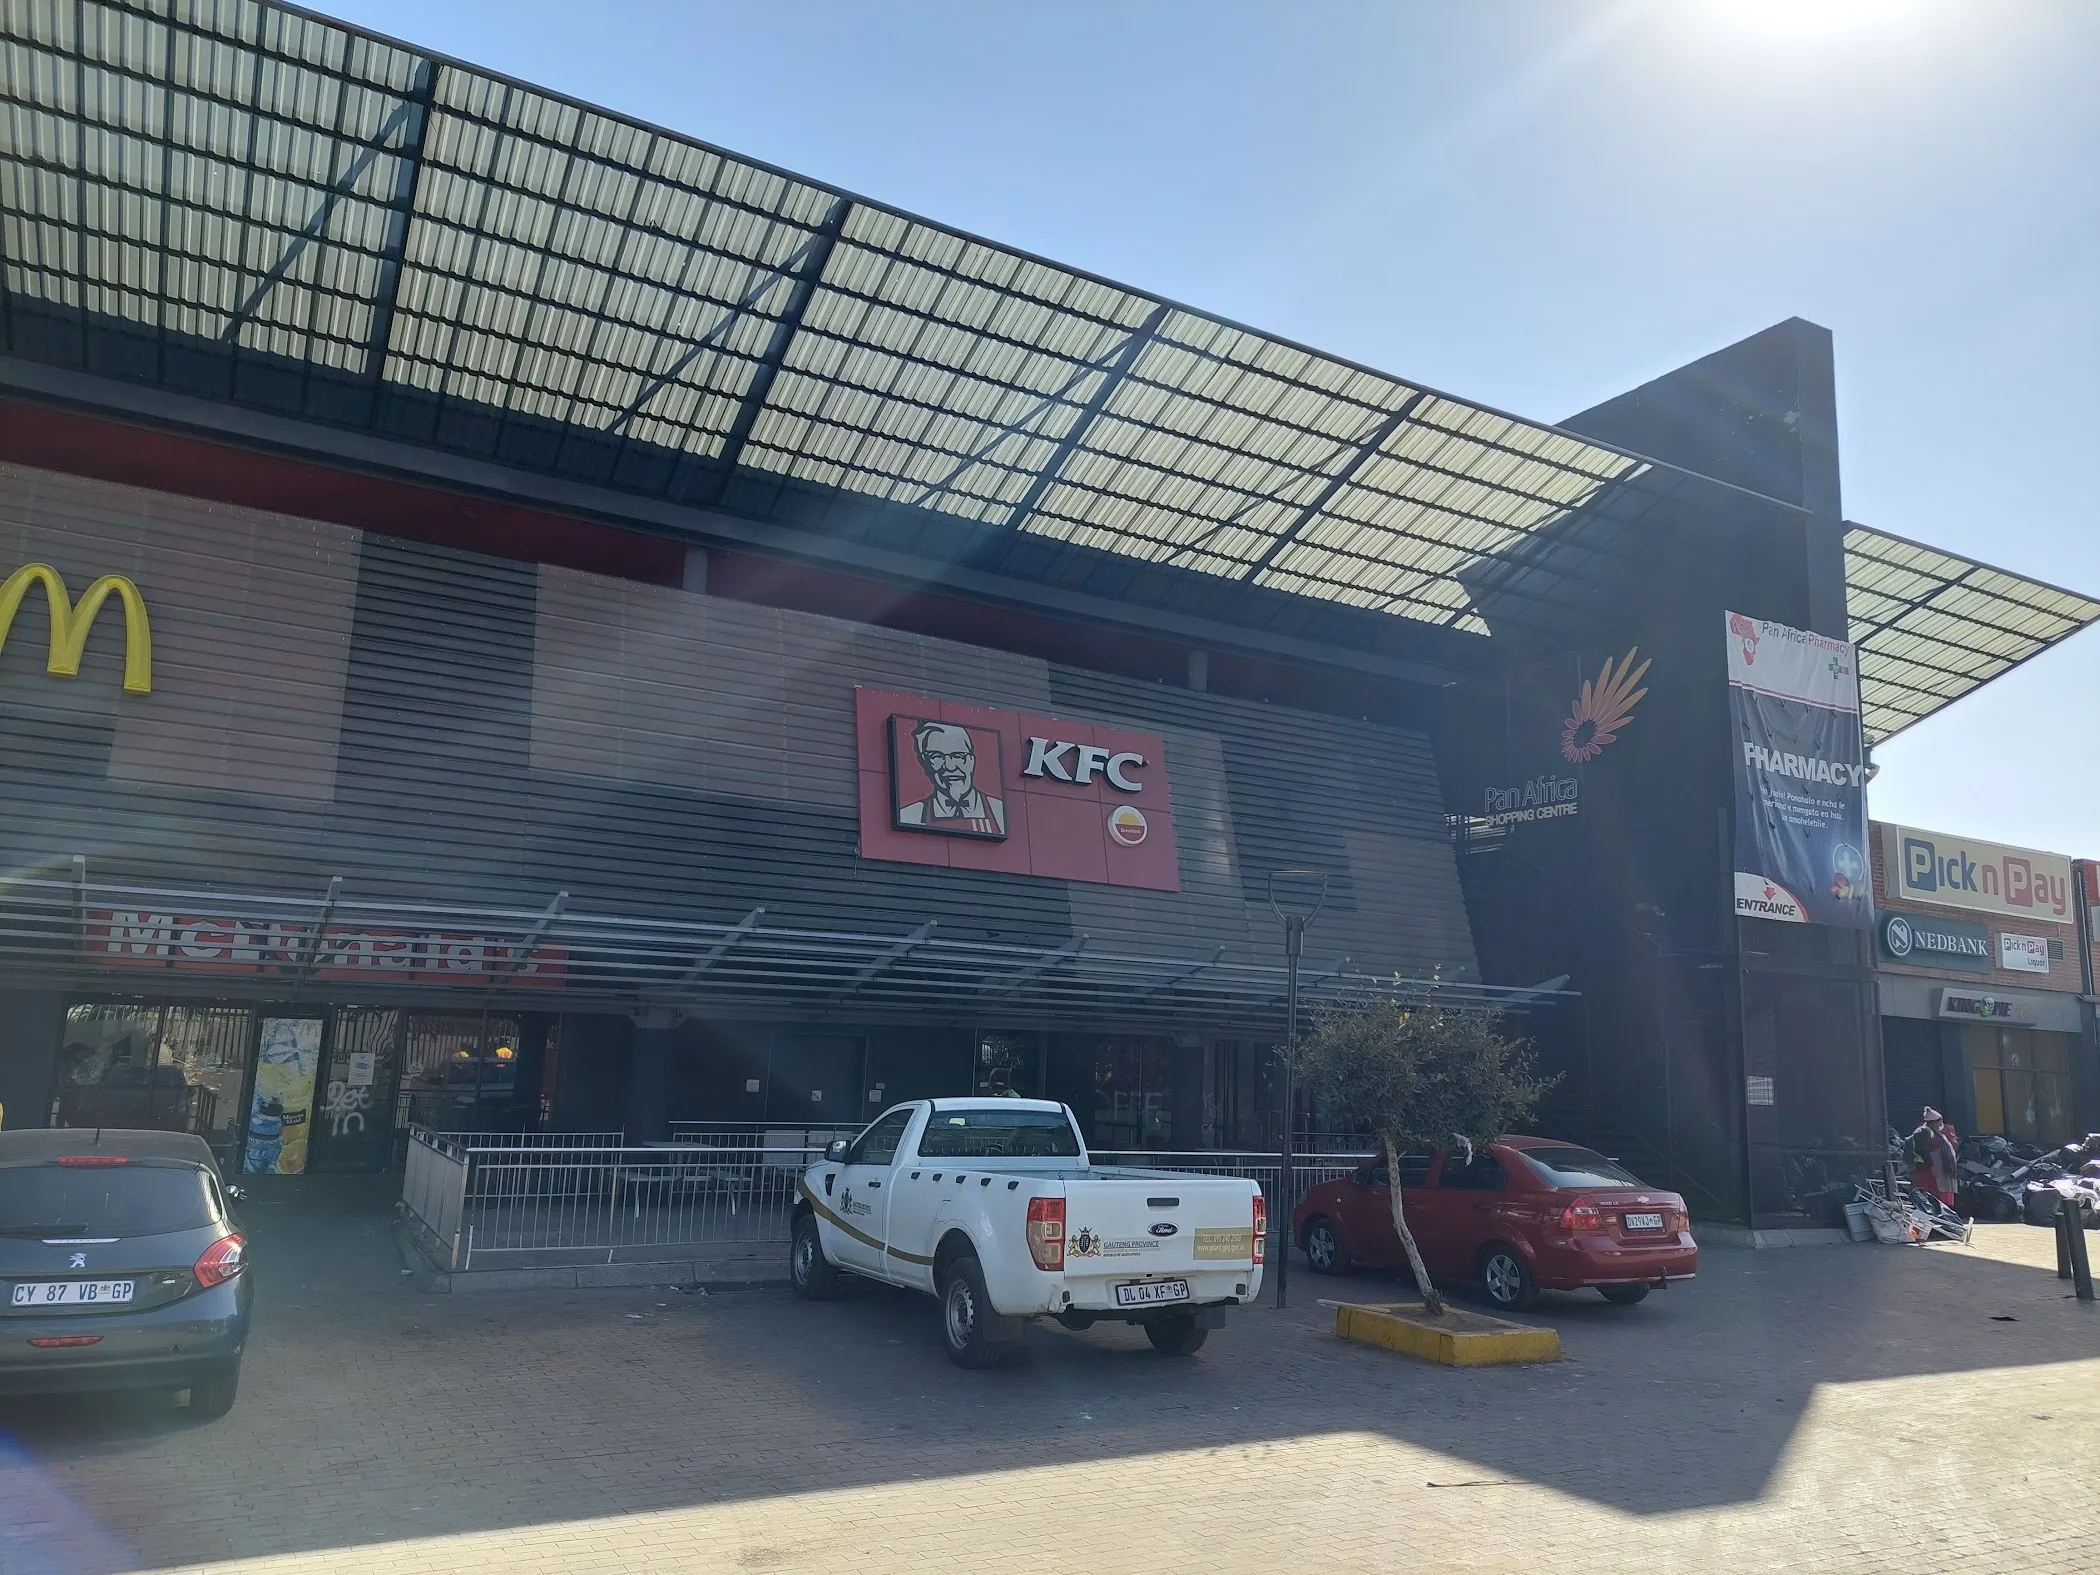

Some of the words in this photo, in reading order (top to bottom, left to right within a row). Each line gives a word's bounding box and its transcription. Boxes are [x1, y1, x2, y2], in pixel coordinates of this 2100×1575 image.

[1762, 622, 1779, 637] Pan
[1781, 627, 1806, 643] Africa
[1808, 633, 1849, 657] Pharmacy
[1022, 736, 1144, 792] KFC
[1744, 741, 1861, 787] PHARMACY
[1484, 787, 1520, 812] Pan
[1522, 775, 1578, 806] Africa
[1485, 809, 1534, 826] SHOPPING
[1536, 802, 1577, 819] CENTRE
[1905, 839, 1978, 892] Pick
[1982, 864, 1999, 896] n
[2004, 856, 2066, 915] Pay
[1736, 897, 1796, 916] ENTRANCE
[1914, 931, 1988, 956] NEDBANK
[2004, 938, 2021, 951] Pick
[2022, 944, 2027, 952] n
[2027, 941, 2044, 955] Pay
[2028, 958, 2045, 967] Liquor
[1155, 1225, 1174, 1234] Ford
[1103, 1241, 1131, 1249] GAUTENG
[1131, 1240, 1159, 1248] PROVINCE
[15, 1286, 36, 1302] CY
[46, 1285, 67, 1301] 87
[79, 1284, 98, 1300] VB
[112, 1283, 133, 1299] GP
[1124, 1287, 1136, 1302] DL
[1139, 1286, 1151, 1300] 04
[1155, 1285, 1165, 1298] XF
[1174, 1283, 1186, 1297] GP
